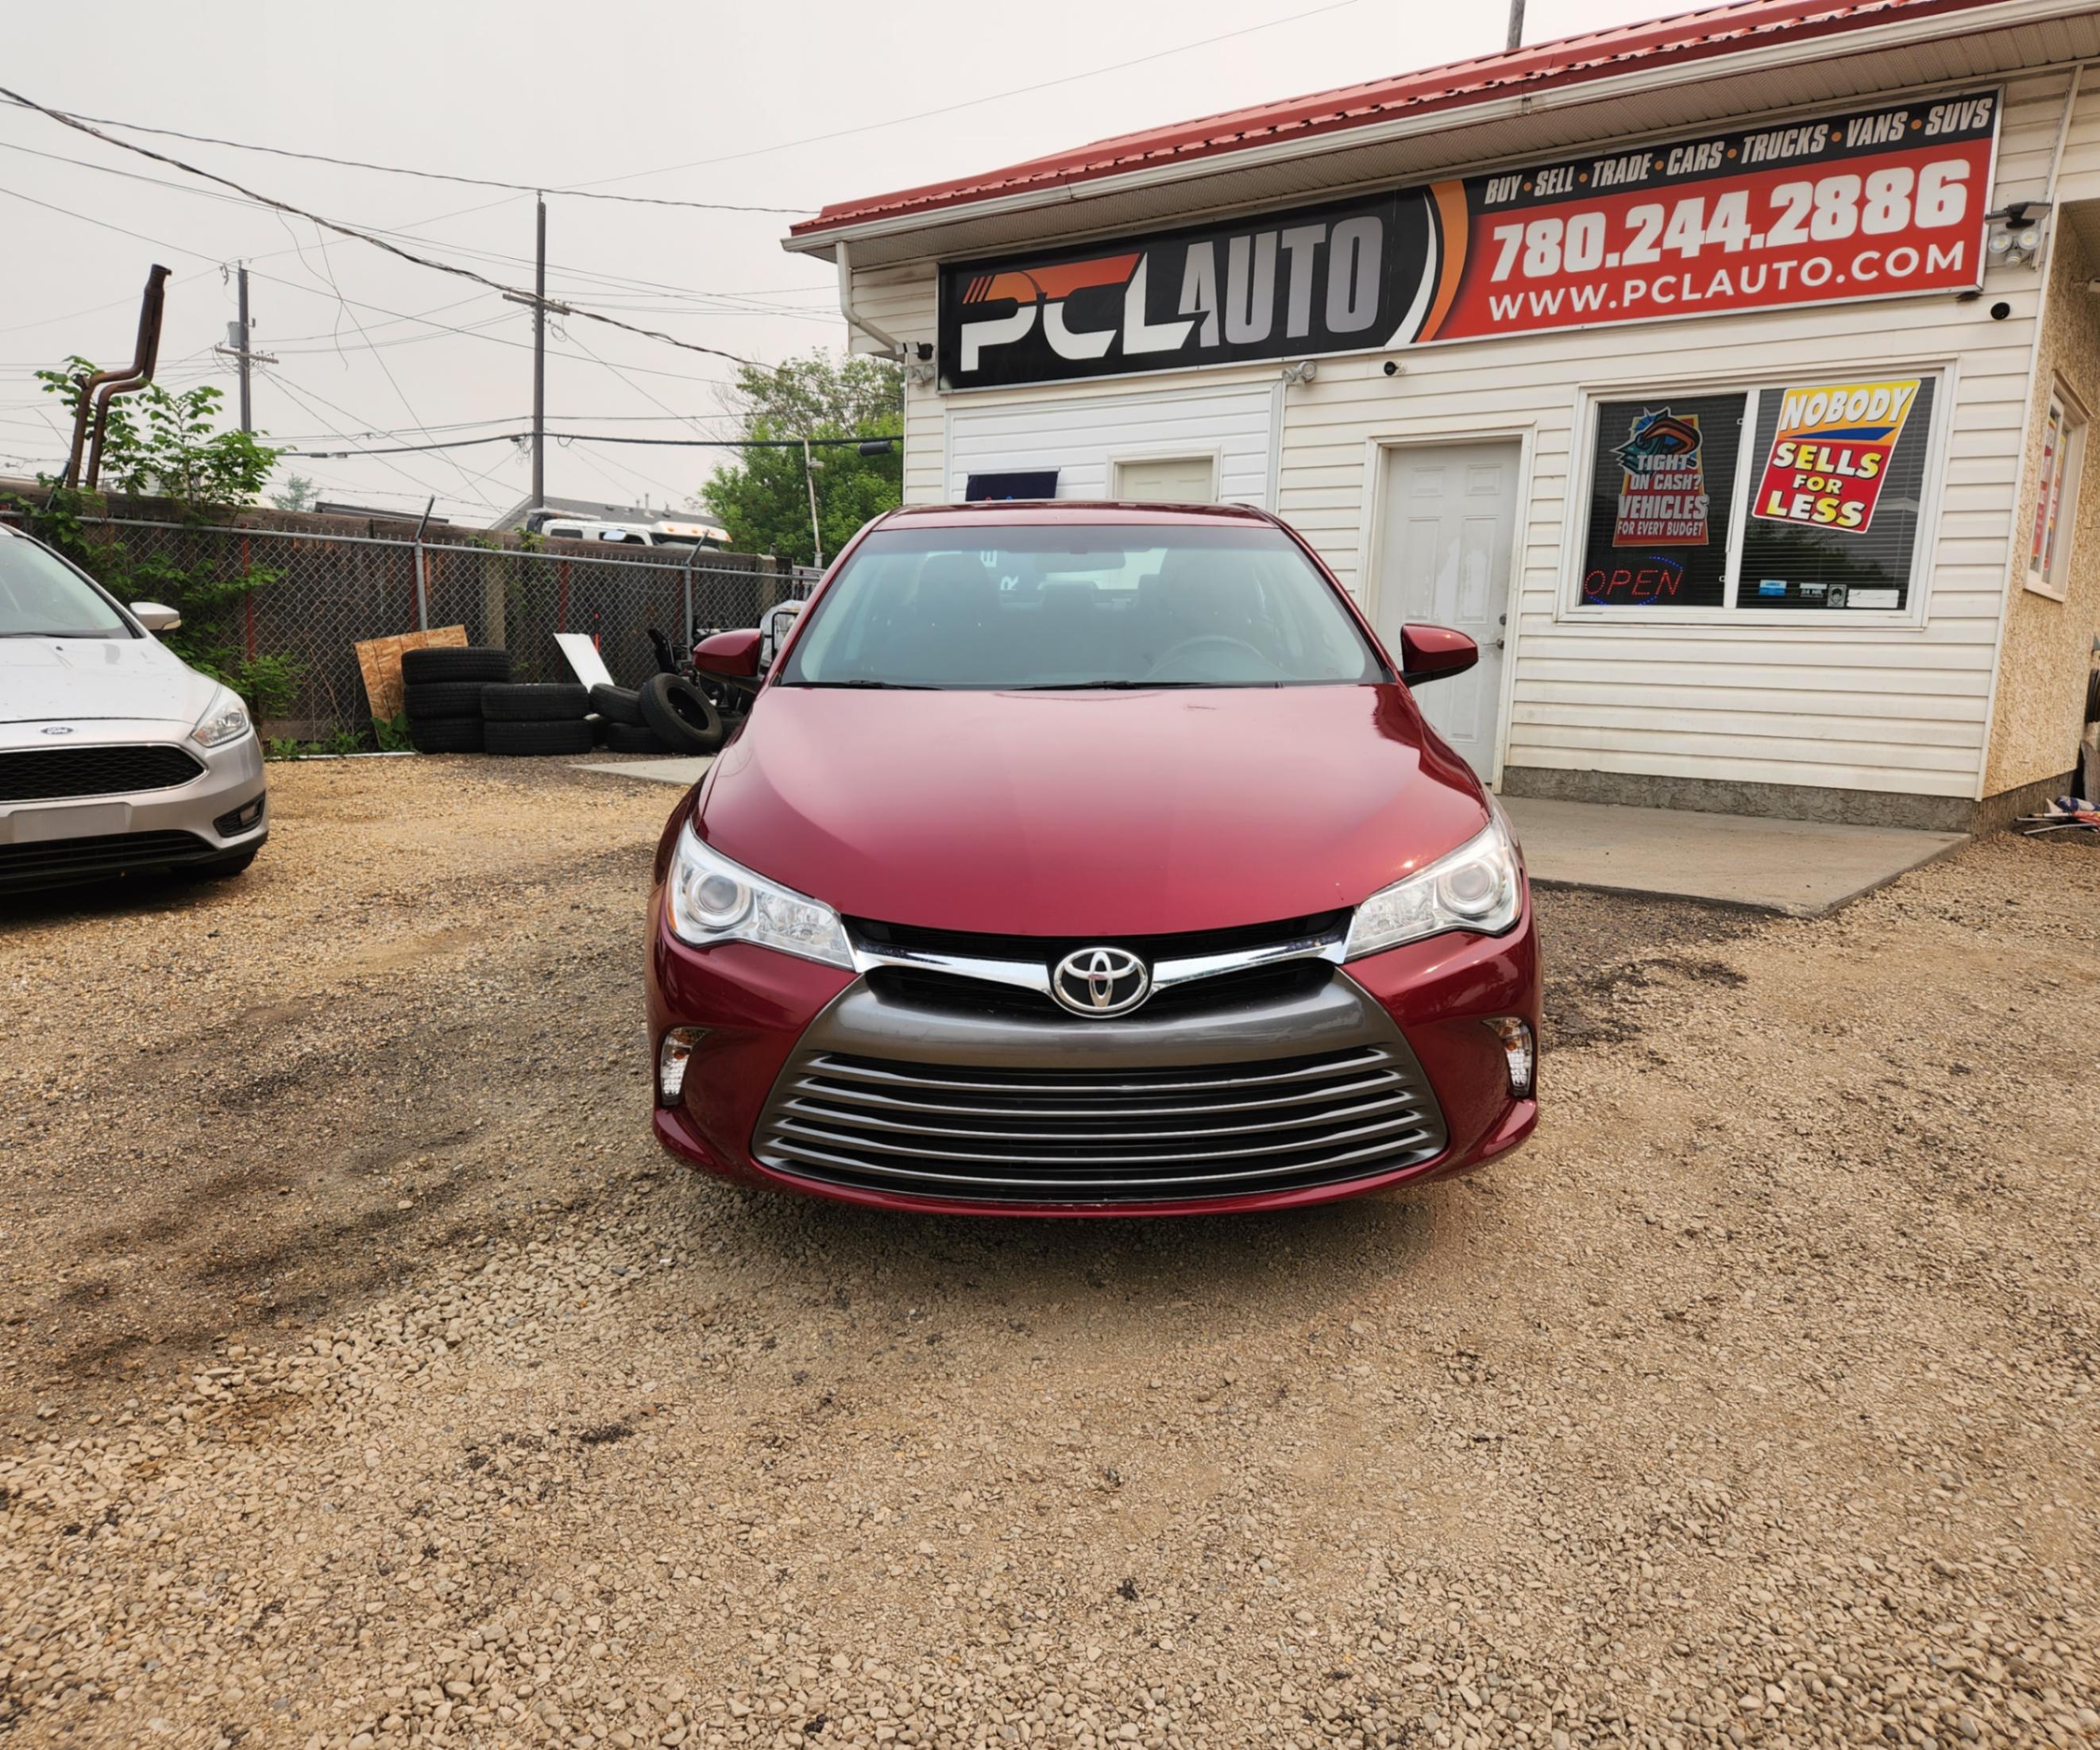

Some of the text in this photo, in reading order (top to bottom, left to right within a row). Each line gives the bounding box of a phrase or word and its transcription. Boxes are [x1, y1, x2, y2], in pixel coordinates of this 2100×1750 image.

[1484, 98, 1993, 204] BUY SELL TRADE CARS TRUCKS VANS SUVS
[1490, 159, 1971, 282] 780.244.2886
[960, 215, 1384, 372] PCL AUTO
[1488, 241, 1965, 321] WWW.PCLAUTO.COM
[1779, 386, 1914, 431] NOBODY
[1637, 454, 1690, 470] TIGHT
[1772, 442, 1882, 479] SELLS
[1630, 474, 1703, 490] ON CASH?
[1792, 473, 1843, 494] FOR
[1618, 495, 1709, 520] VEHICLES
[1766, 490, 1866, 527] LESS
[1617, 521, 1704, 536] FOR EVERY BUDGET
[1585, 569, 1683, 596] OPEN
